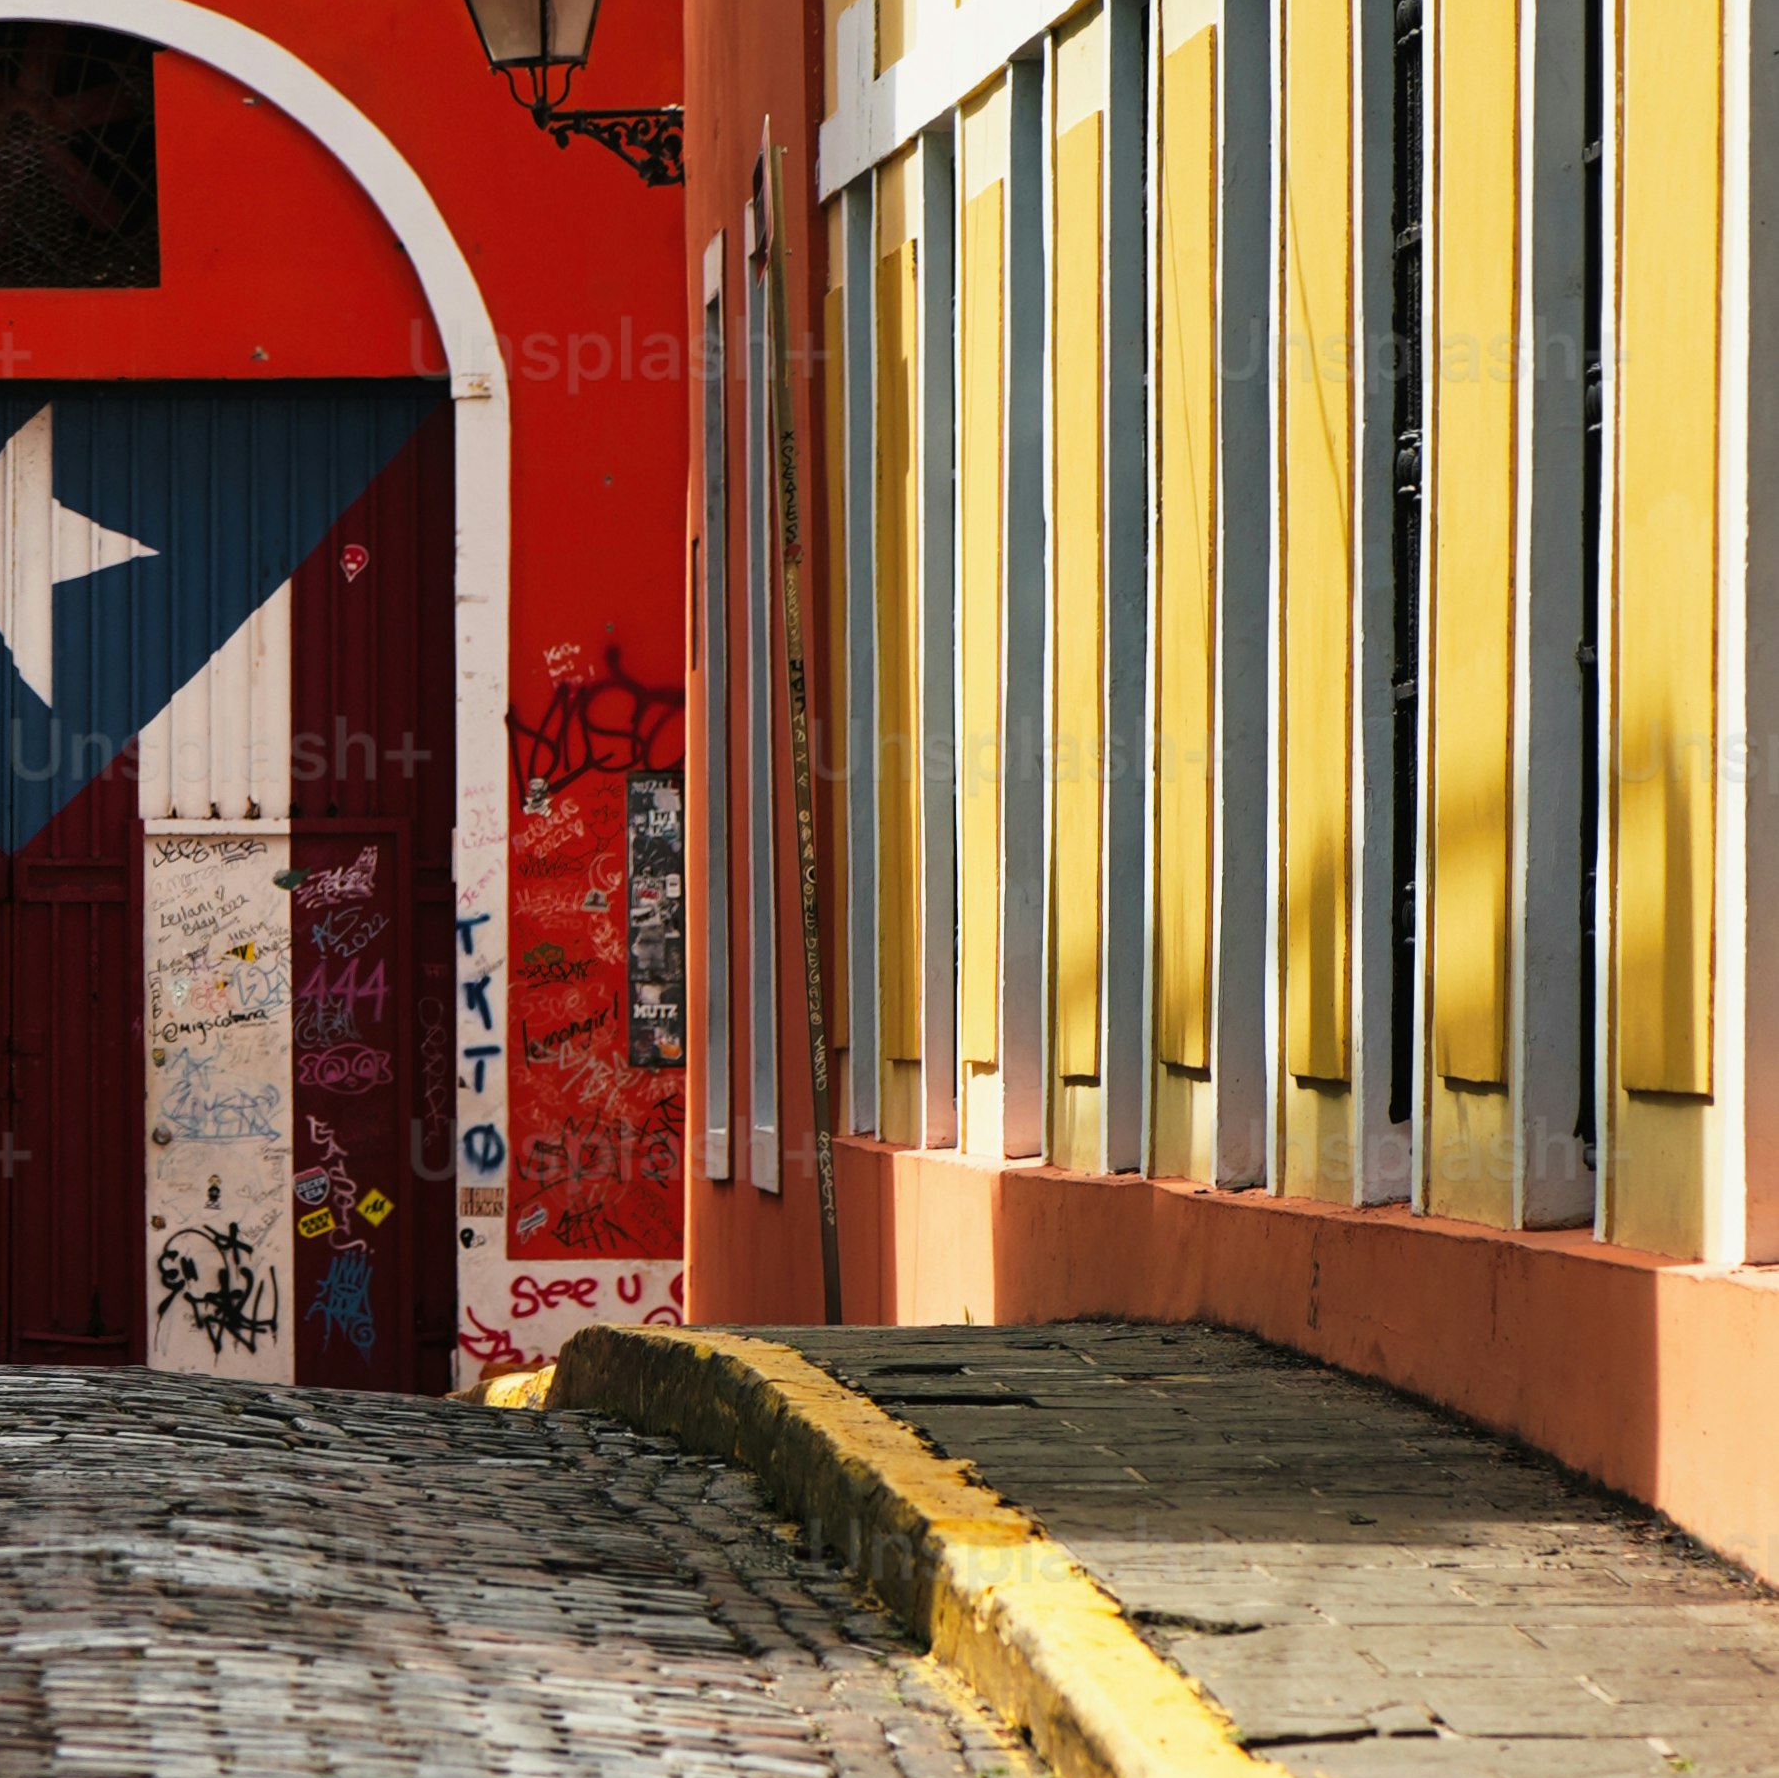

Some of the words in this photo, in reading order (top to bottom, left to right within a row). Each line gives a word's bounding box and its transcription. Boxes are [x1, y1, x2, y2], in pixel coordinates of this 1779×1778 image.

[334, 913, 390, 958] 2022
[299, 956, 390, 1023] 444
[511, 1275, 598, 1319] See
